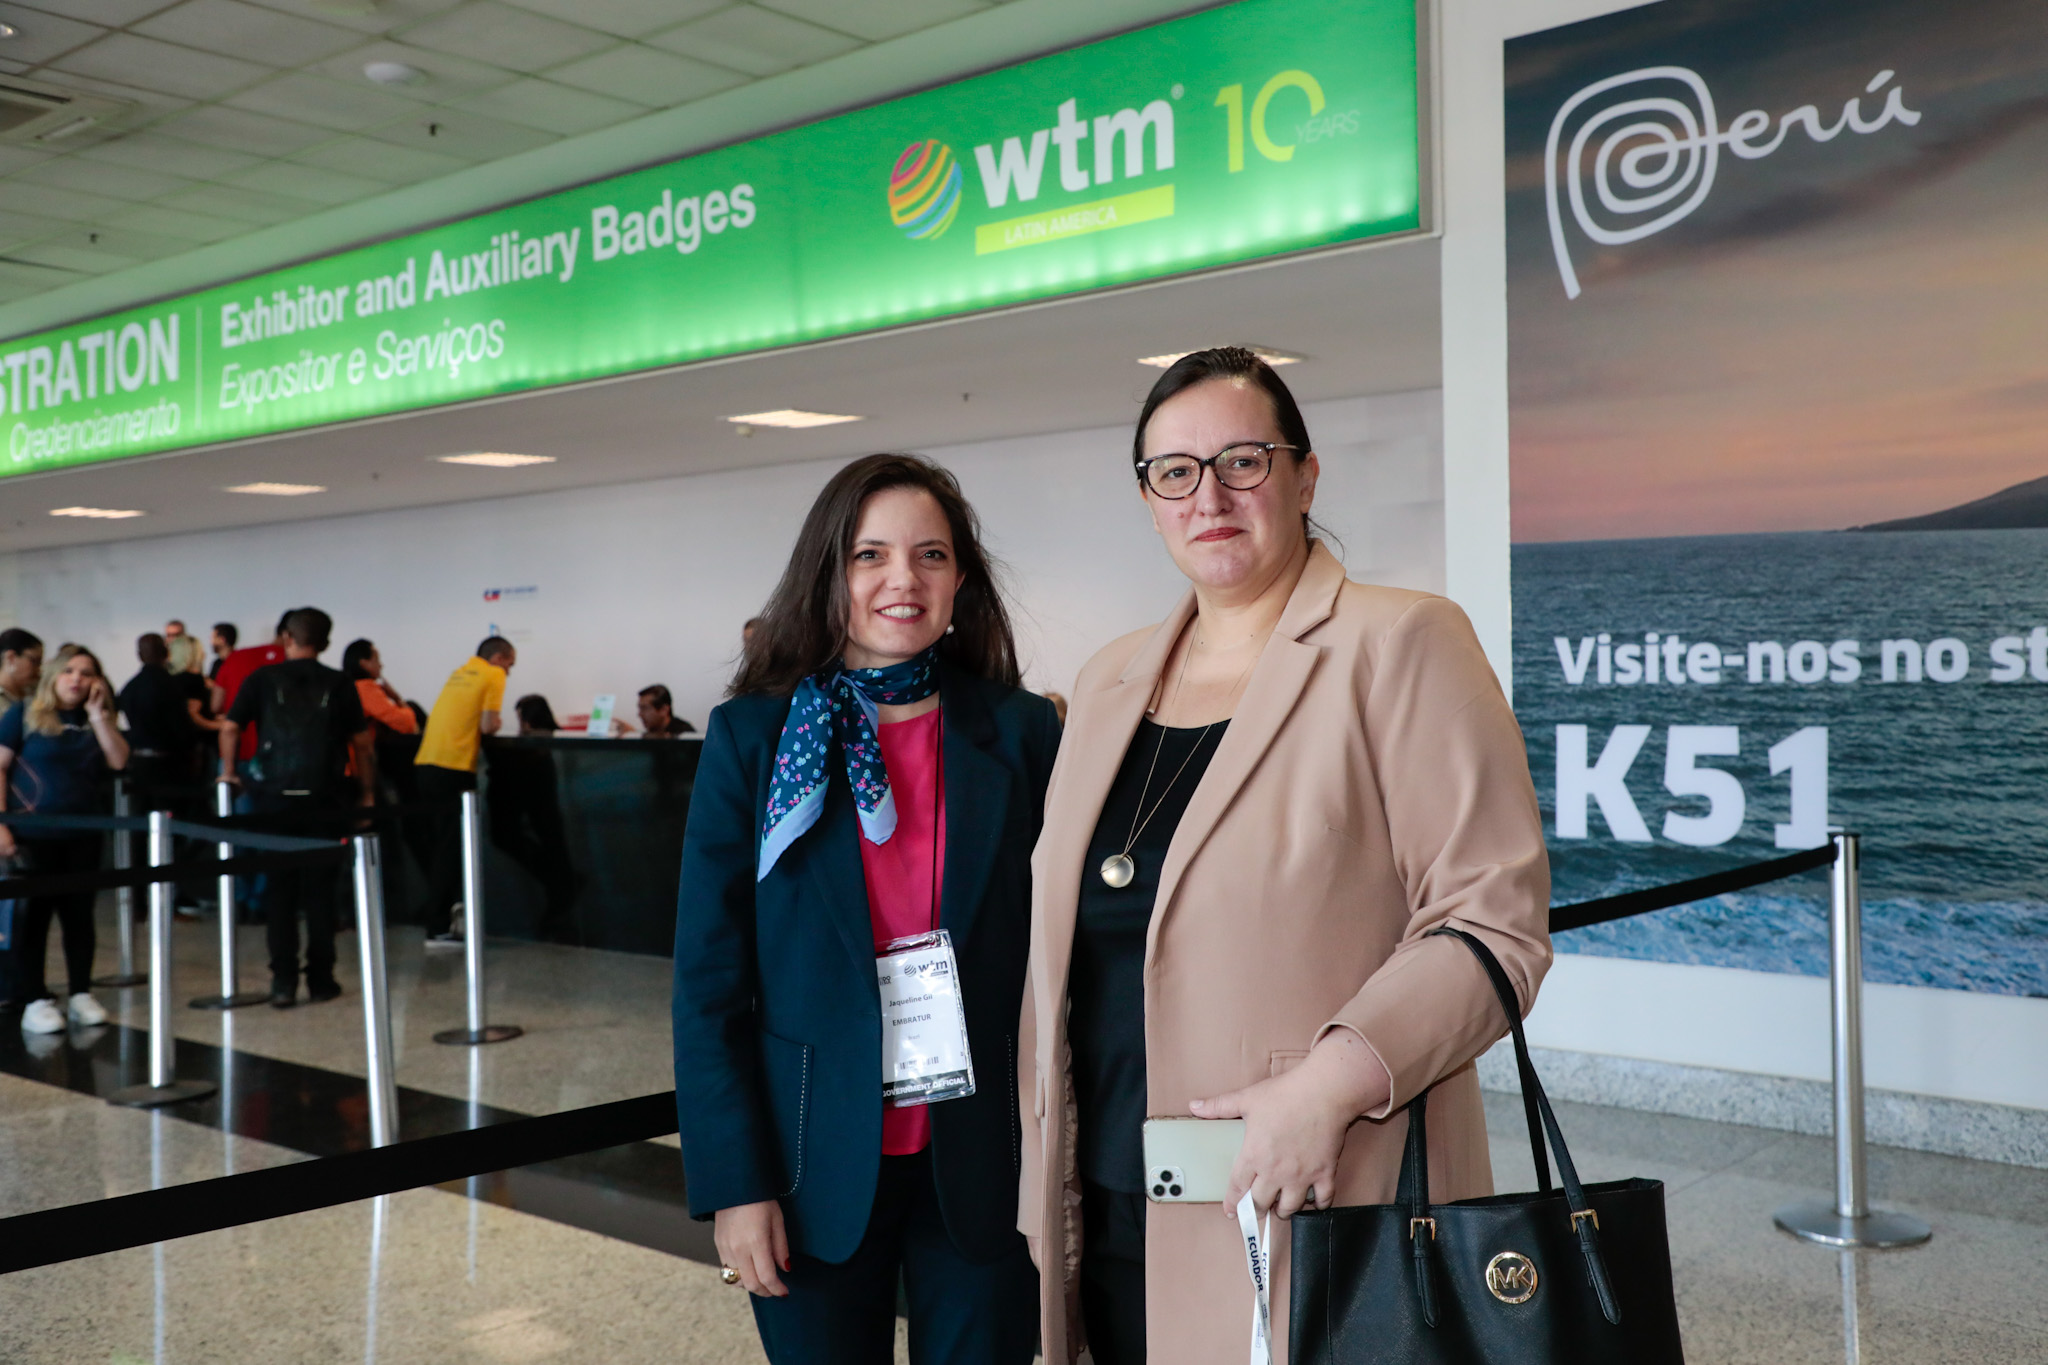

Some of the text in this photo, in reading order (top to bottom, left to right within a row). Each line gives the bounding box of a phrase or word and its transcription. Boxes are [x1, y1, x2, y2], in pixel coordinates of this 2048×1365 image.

[1213, 68, 1326, 174] 10
[1295, 108, 1361, 144] YEARS
[974, 97, 1175, 209] wtm
[1545, 65, 1922, 300] Perú
[1004, 204, 1118, 245] LATIN AMERICA
[220, 183, 757, 349] Exhibitor and Auxiliary Badges
[0, 313, 180, 420] TRATION
[219, 318, 507, 414] Expositor e Serviços
[9, 395, 181, 462] Credenciamento
[1554, 632, 1862, 685] Visite-nos
[1881, 636, 1971, 684] no
[1555, 723, 1844, 850] K51
[889, 996, 922, 1008] Jaqueline
[892, 1013, 932, 1027] EMBRATUR
[932, 1077, 967, 1088] OFFICIAL
[1247, 1235, 1264, 1293] ECUADOR
[1491, 1266, 1532, 1290] MK
